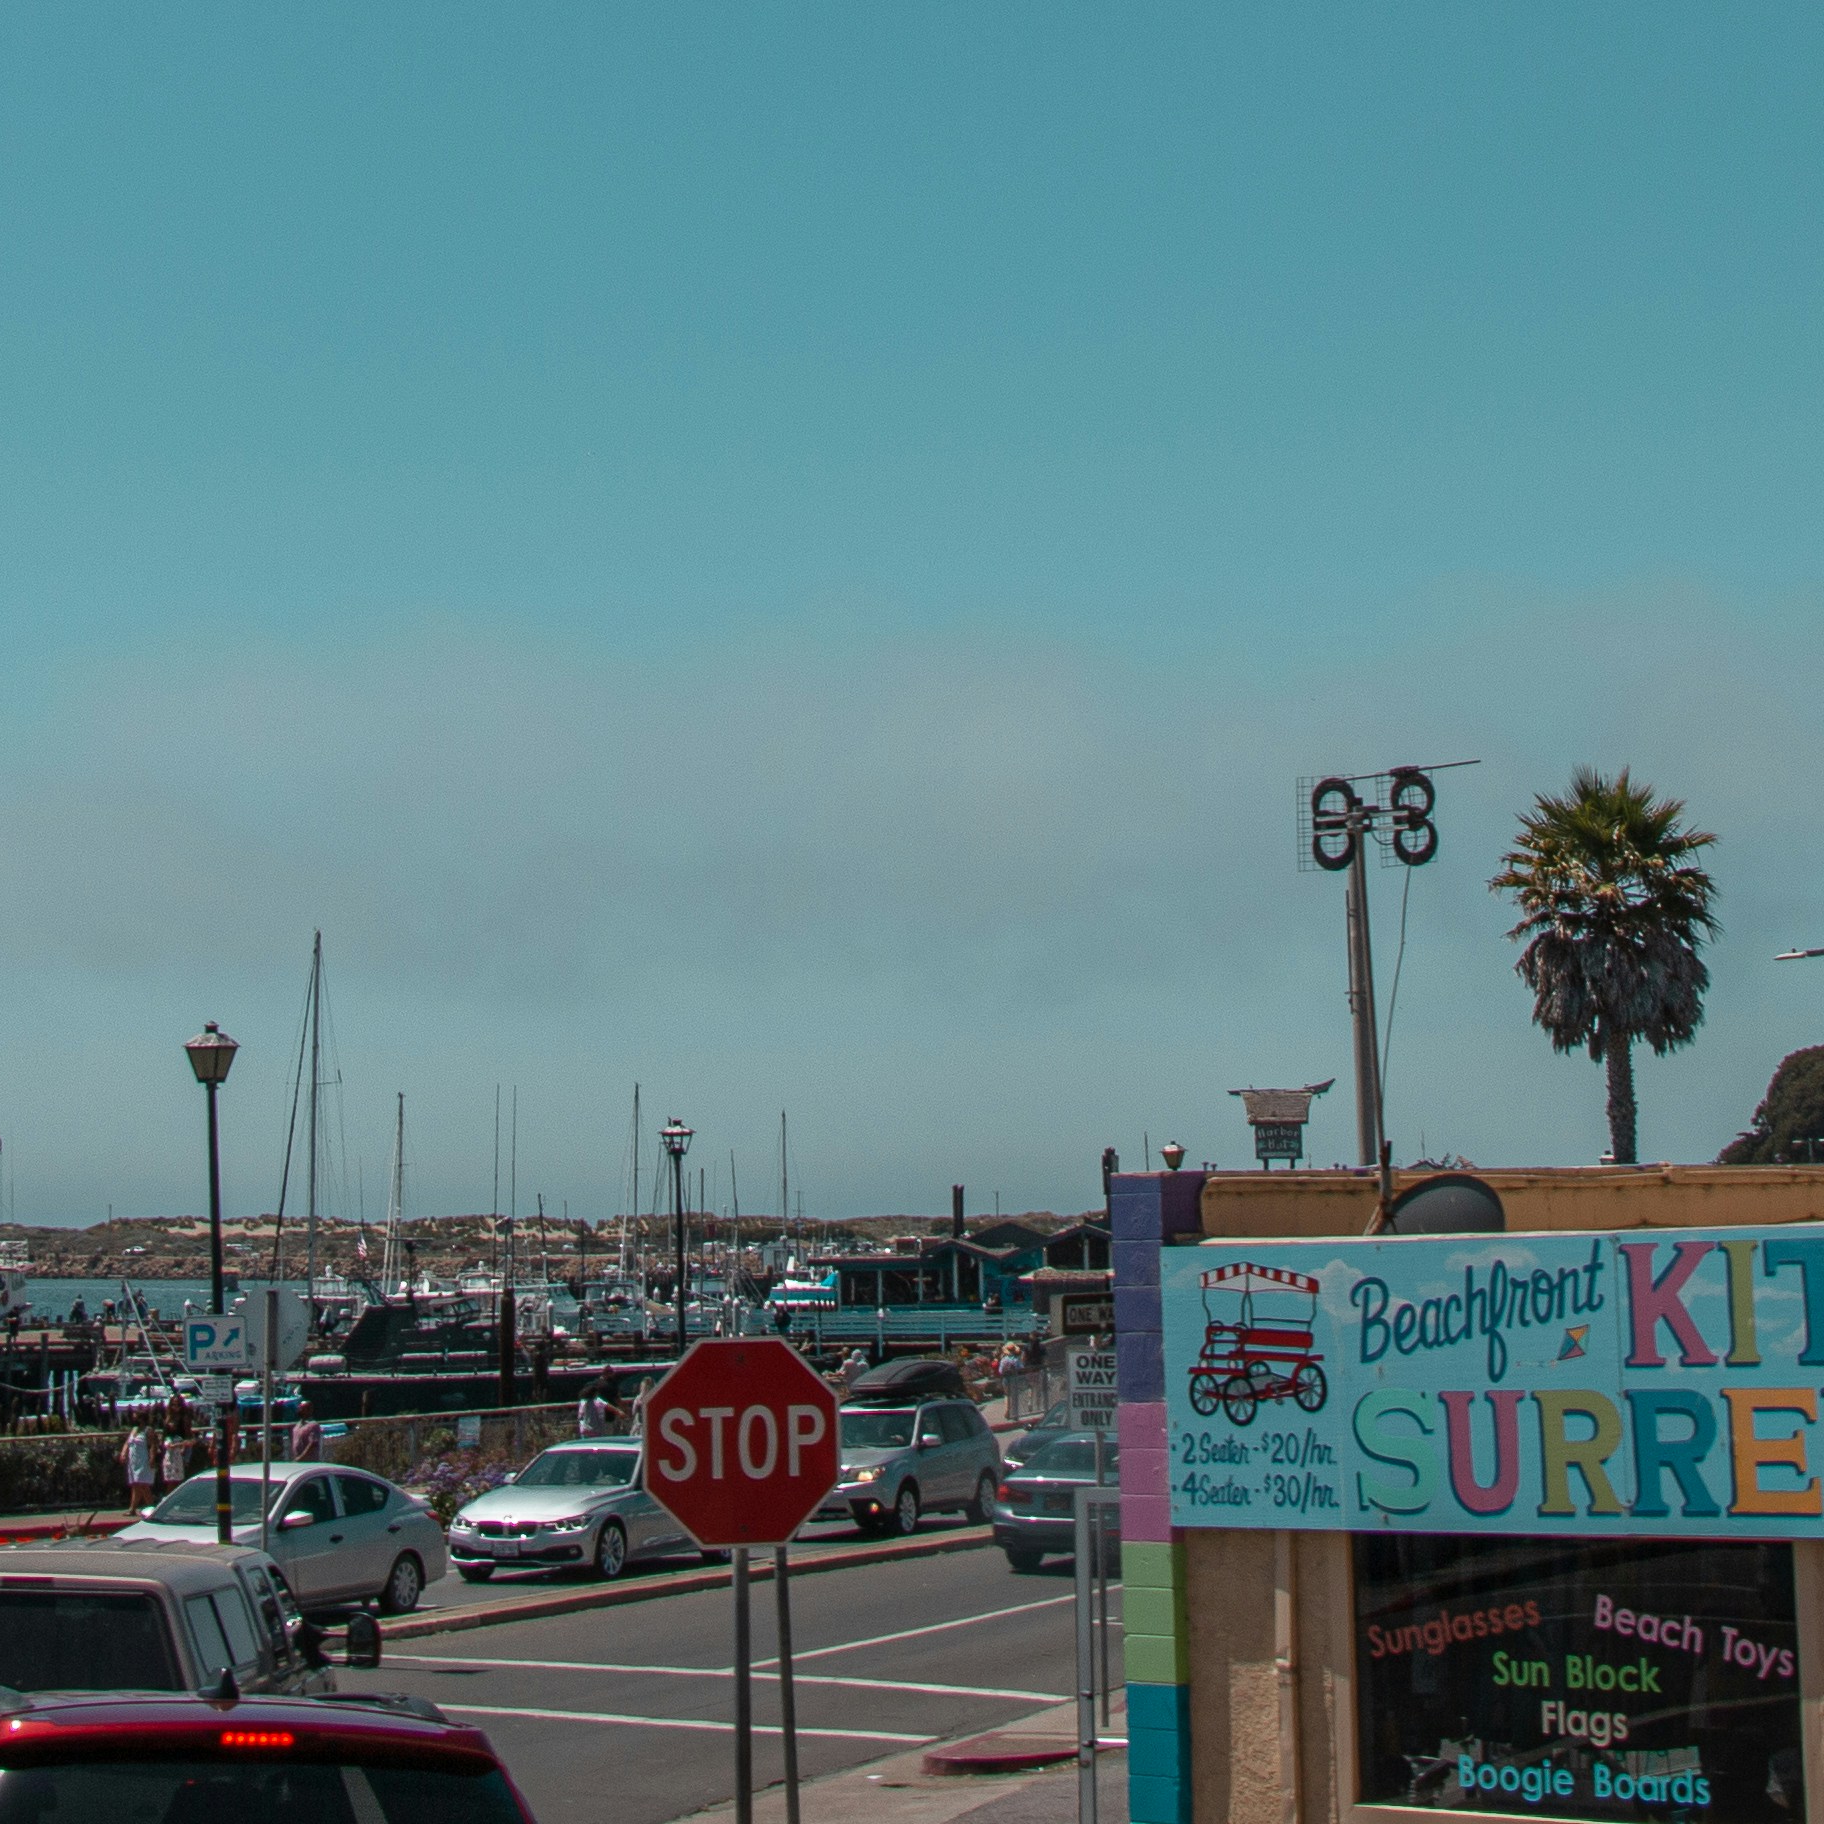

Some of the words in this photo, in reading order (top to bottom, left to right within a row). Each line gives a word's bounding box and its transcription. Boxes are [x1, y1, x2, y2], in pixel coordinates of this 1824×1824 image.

[1069, 1307, 1092, 1323] ONE
[1098, 1306, 1115, 1322] WA
[1350, 1238, 1604, 1382] Beachfront
[1075, 1370, 1117, 1385] WAY
[1076, 1355, 1116, 1370] ONE
[1072, 1392, 1117, 1408] ENTRANC
[1080, 1411, 1113, 1426] ONLY
[658, 1404, 826, 1483] STOP
[1367, 1600, 1541, 1658] Sunglasses
[1594, 1593, 1704, 1654] Beach
[1720, 1625, 1796, 1680] Toys
[1492, 1650, 1551, 1688] Sun
[1566, 1654, 1662, 1693] Block
[1541, 1699, 1630, 1748] Flags
[1457, 1753, 1575, 1802] Boogie
[1593, 1762, 1712, 1806] Boards
